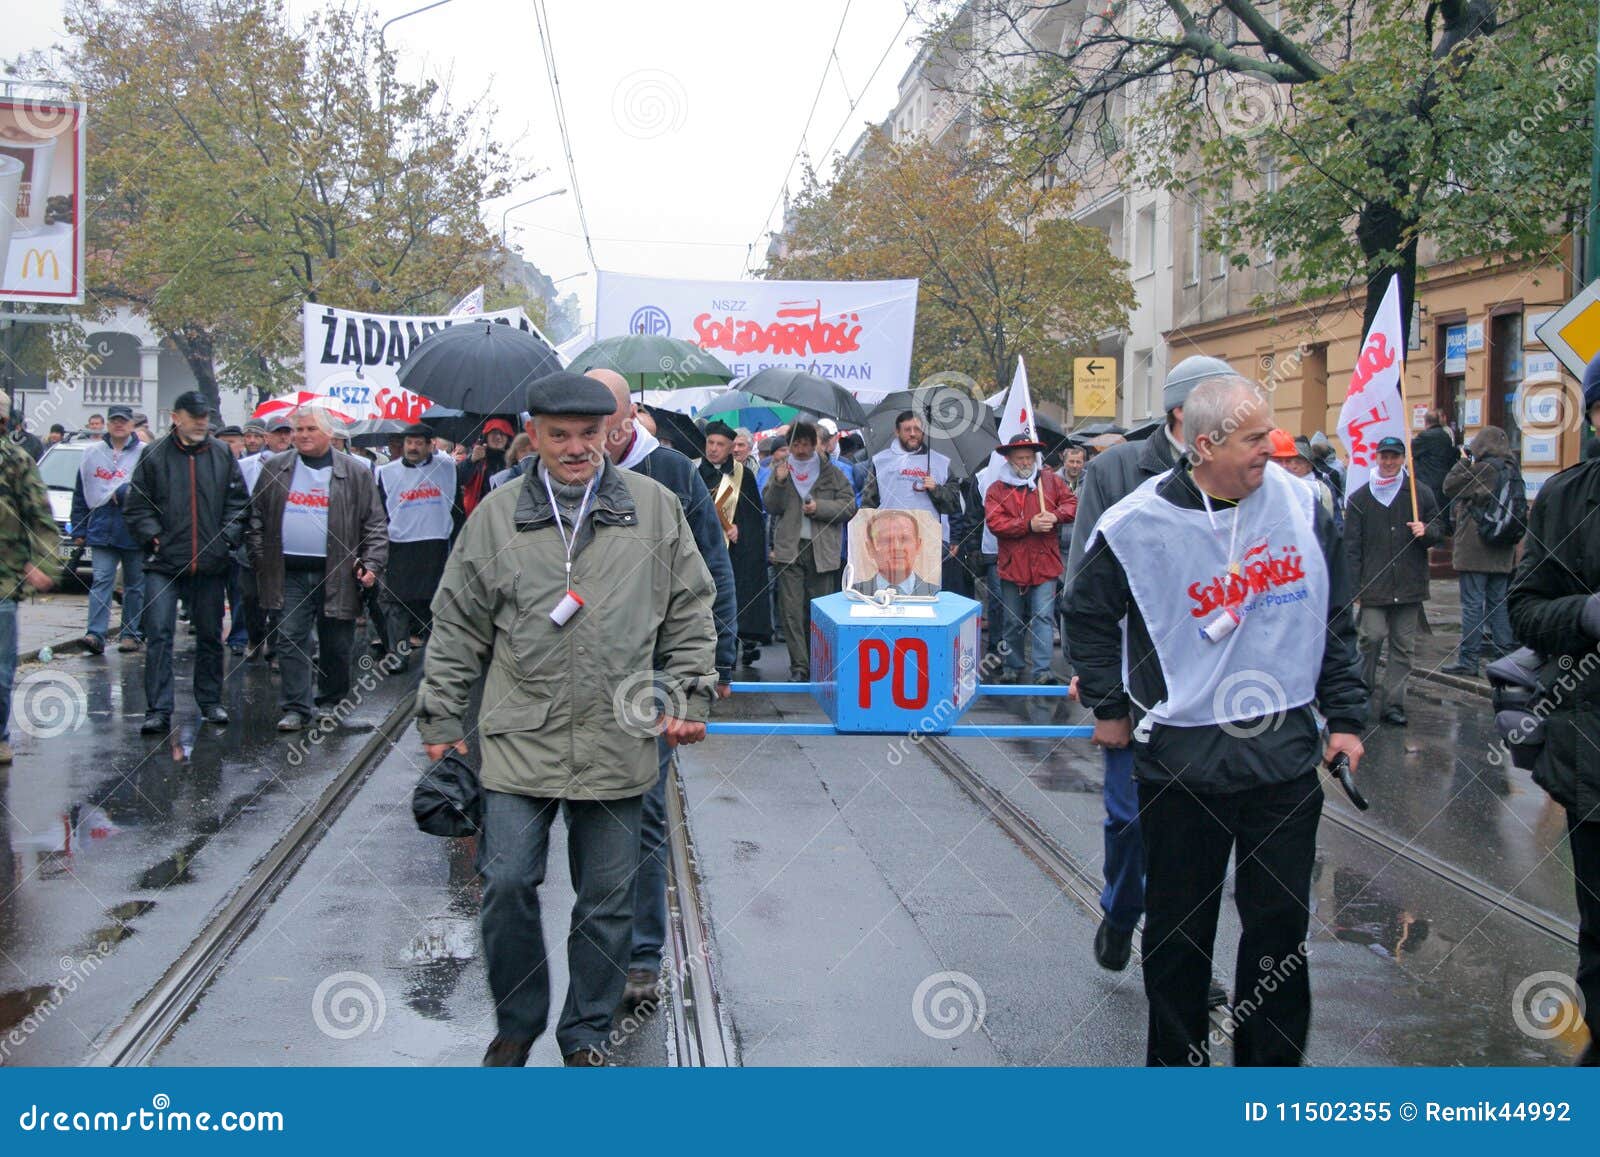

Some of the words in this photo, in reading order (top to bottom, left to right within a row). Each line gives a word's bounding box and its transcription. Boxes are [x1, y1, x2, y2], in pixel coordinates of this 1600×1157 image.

[712, 300, 746, 311] NSZZ
[329, 387, 370, 404] NSZZ
[858, 637, 929, 710] PO
